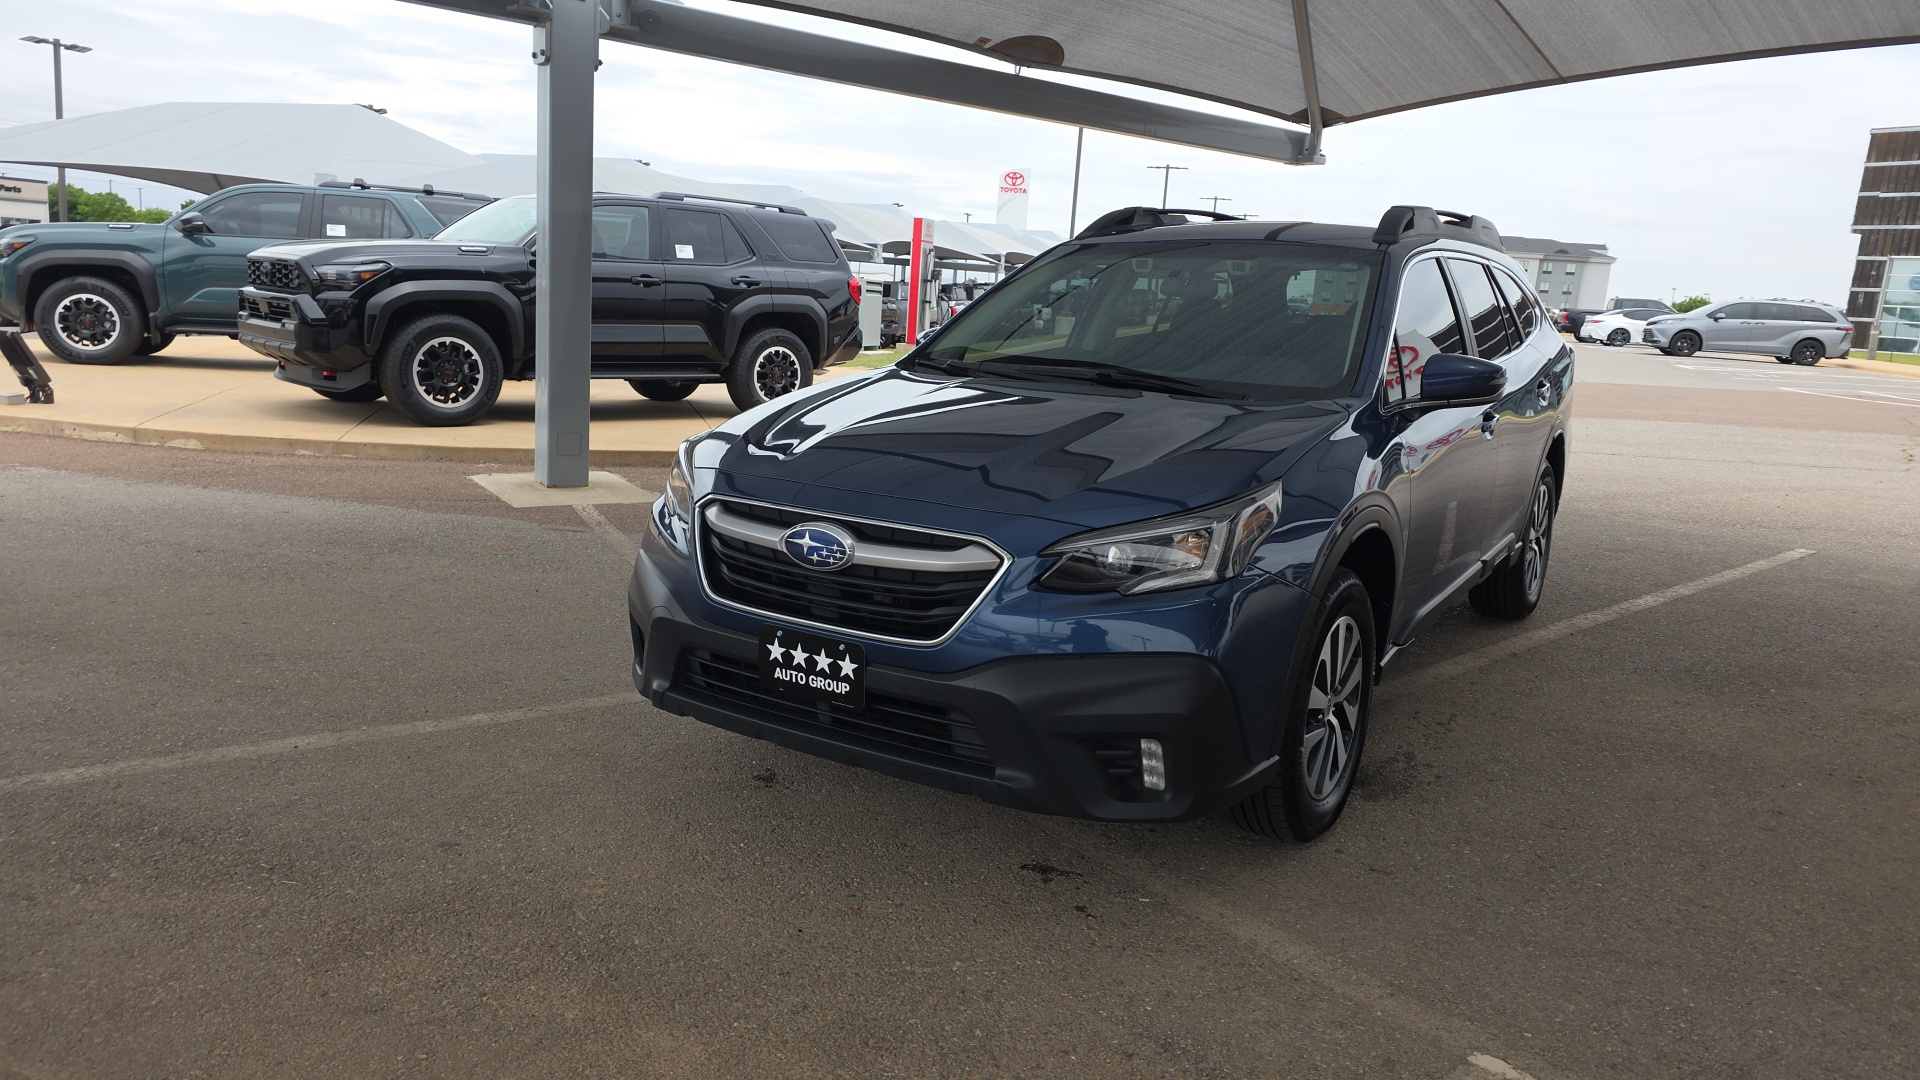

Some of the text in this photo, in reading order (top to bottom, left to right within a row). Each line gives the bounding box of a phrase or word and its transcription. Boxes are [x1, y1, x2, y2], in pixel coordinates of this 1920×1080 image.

[1000, 186, 1028, 194] TOYOTA
[774, 667, 850, 695] AUTO GROUP
